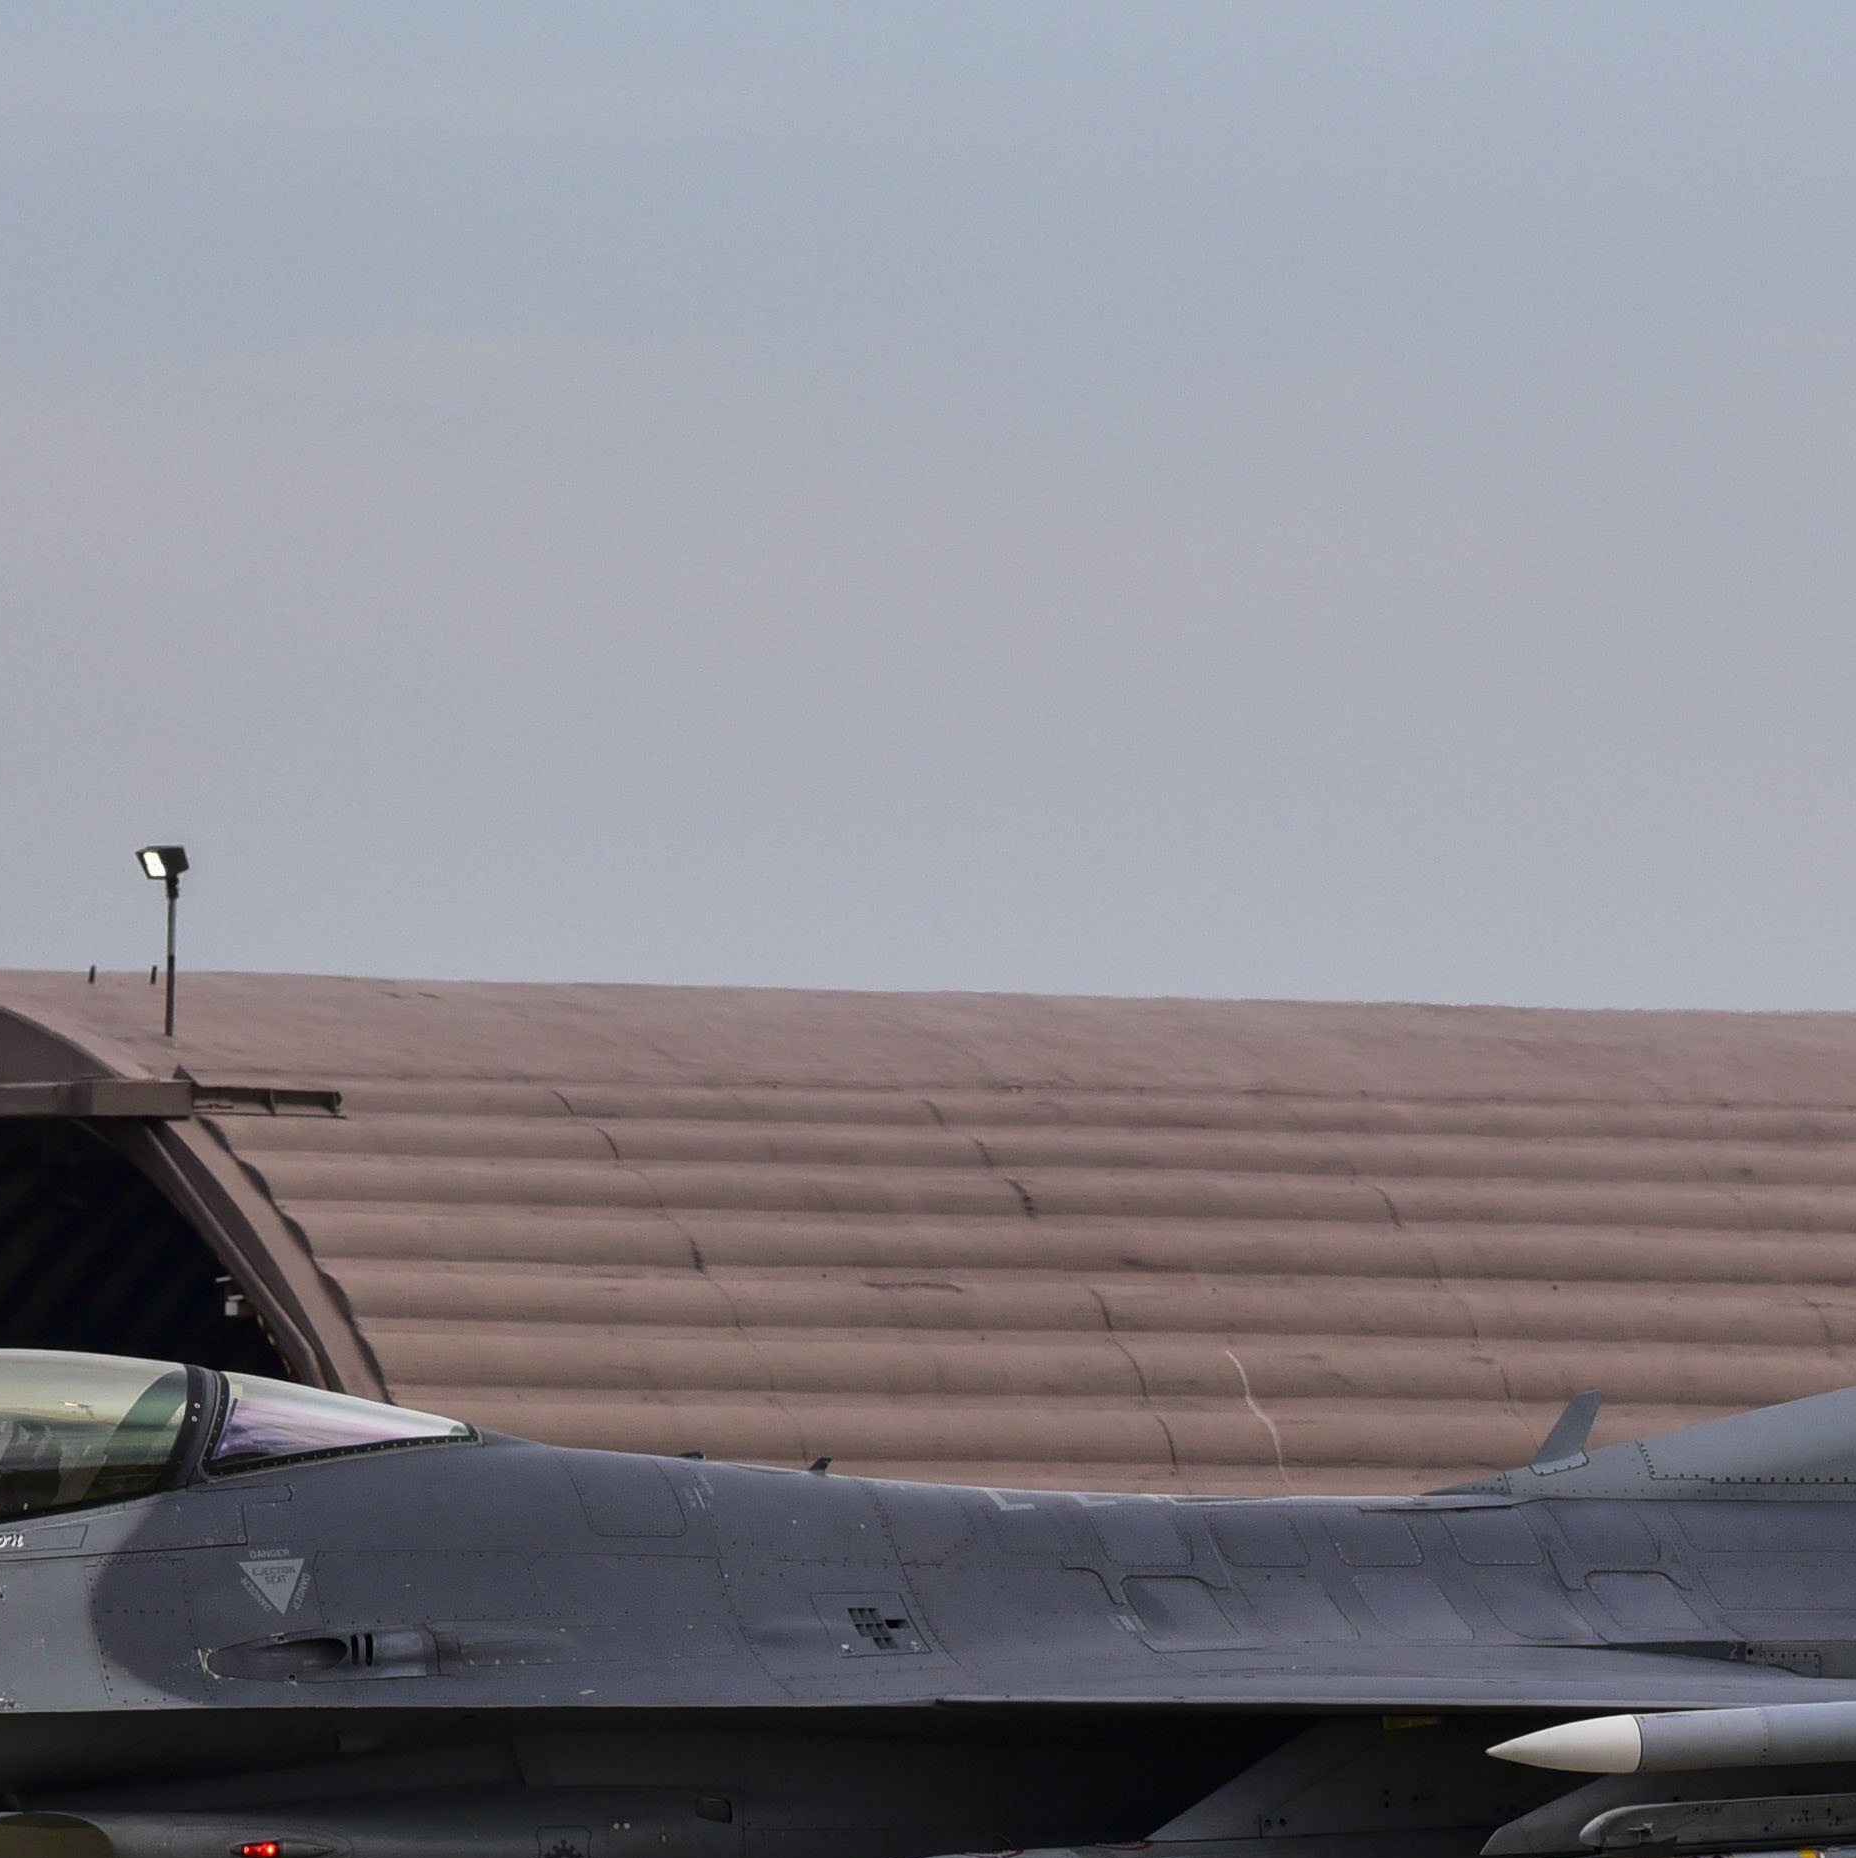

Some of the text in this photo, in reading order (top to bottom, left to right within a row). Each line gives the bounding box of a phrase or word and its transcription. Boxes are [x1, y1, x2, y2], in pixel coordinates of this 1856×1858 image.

[249, 1549, 290, 1560] DANGER
[252, 1566, 296, 1576] EJECTION
[265, 1575, 286, 1585] SEAT
